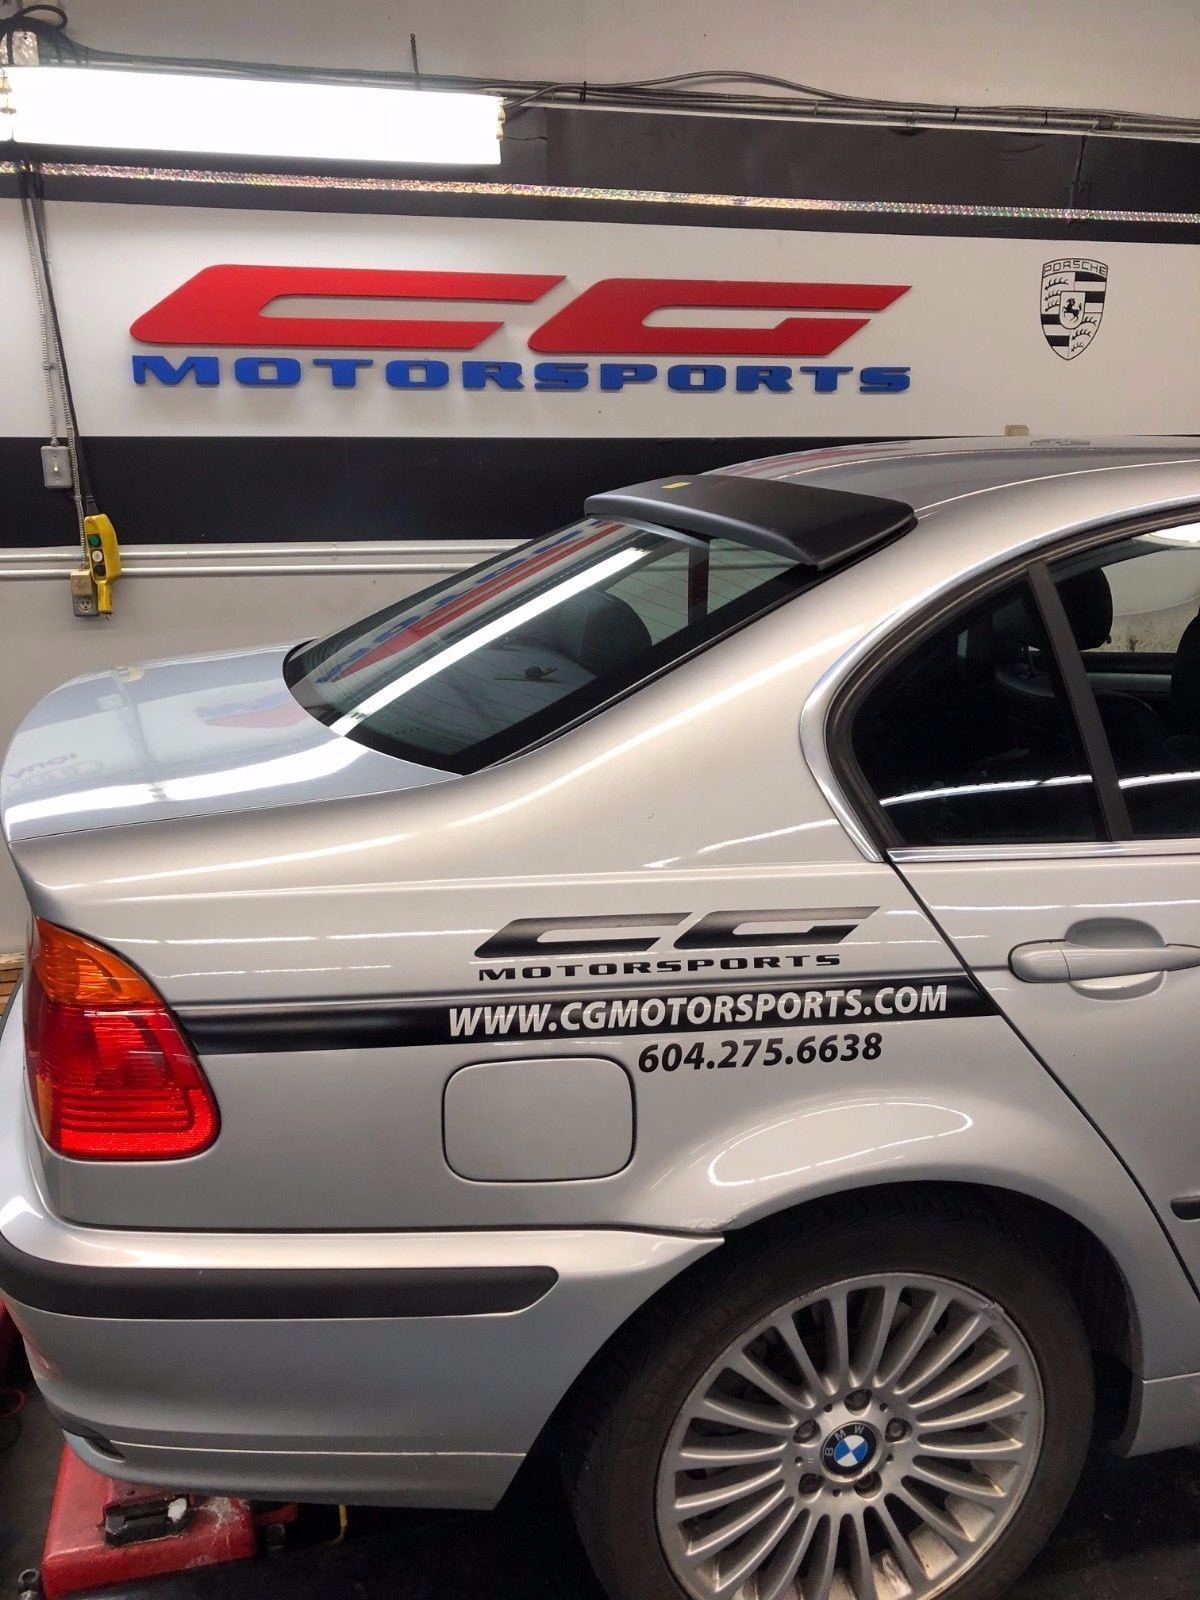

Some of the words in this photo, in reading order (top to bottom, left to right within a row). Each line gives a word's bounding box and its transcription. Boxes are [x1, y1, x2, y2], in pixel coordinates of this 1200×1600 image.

[1043, 260, 1107, 276] PORSCHE
[132, 355, 911, 394] MOTORSPORTS
[478, 954, 841, 981] MOTORSPORTS
[449, 984, 948, 1038] WWW.CGMOTORSPORTS.COM
[638, 1032, 883, 1073] 604.275.6638
[824, 1425, 865, 1457] BMW
